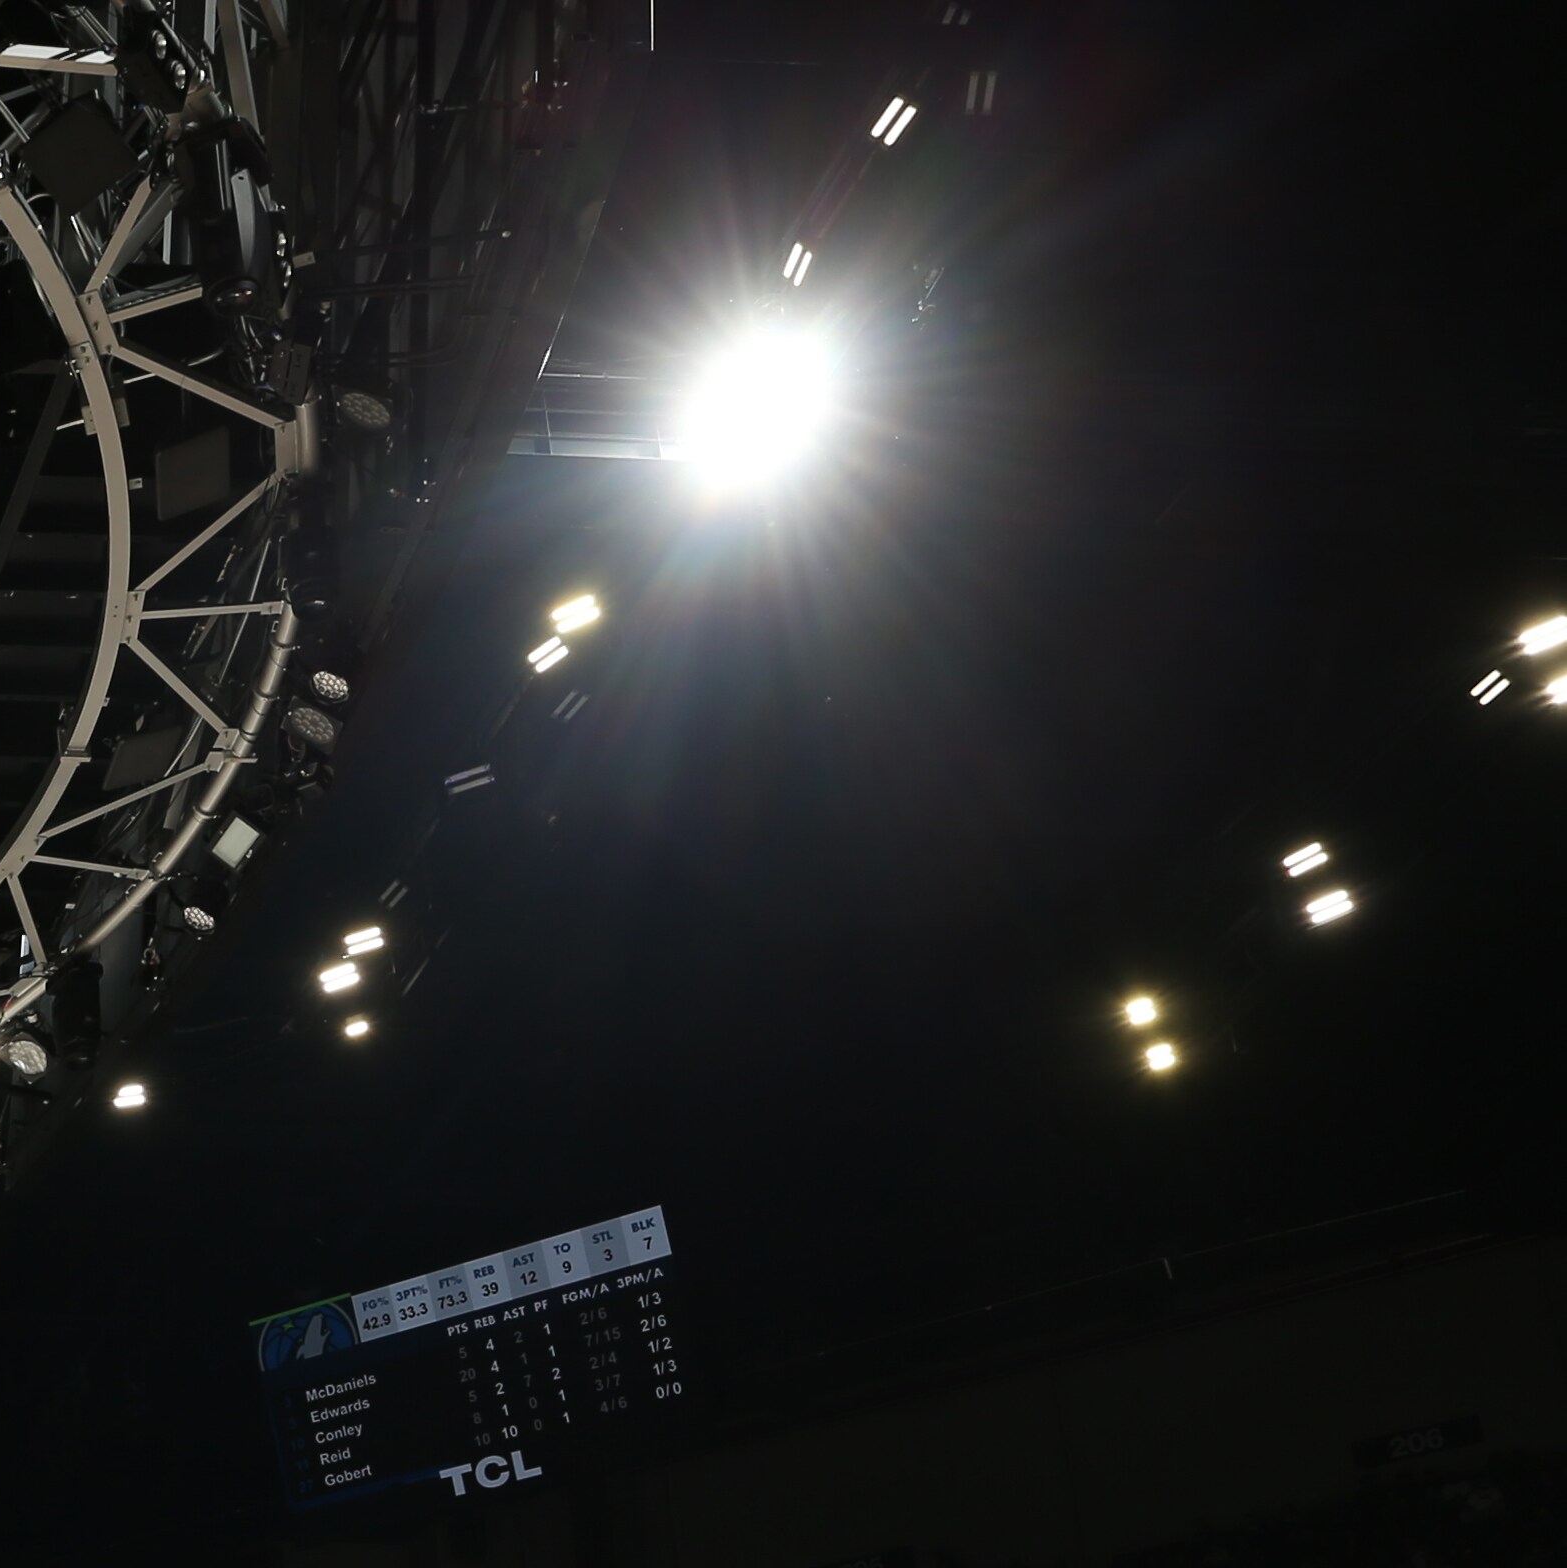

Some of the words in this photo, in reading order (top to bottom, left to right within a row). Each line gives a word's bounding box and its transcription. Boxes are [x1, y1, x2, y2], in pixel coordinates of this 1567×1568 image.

[362, 1296, 389, 1312] FG%
[395, 1285, 429, 1302] 3PT%
[439, 1275, 463, 1289] FT%
[473, 1264, 496, 1280] REB
[512, 1253, 536, 1269] AST
[553, 1242, 571, 1256] TO
[592, 1230, 614, 1245] STL
[631, 1217, 656, 1233] BLK
[362, 1313, 392, 1332] 42.9
[399, 1302, 429, 1321] 33.3
[437, 1291, 468, 1310] 73.3
[481, 1282, 499, 1297] 39
[520, 1270, 538, 1285] 12
[562, 1261, 572, 1273] 9
[603, 1248, 614, 1262] 3
[643, 1237, 653, 1250] 7
[447, 1322, 469, 1337] PTS
[474, 1315, 497, 1329] REB
[503, 1305, 526, 1321] AST
[534, 1300, 549, 1312] PF
[561, 1282, 611, 1304] FGM/A
[616, 1267, 664, 1289] 3PM/A
[305, 1373, 377, 1403] McDaniels
[310, 1398, 371, 1424] Edwards
[315, 1423, 363, 1445] Conley
[319, 1447, 352, 1466] Reid
[324, 1464, 373, 1487] Gobert
[438, 1450, 543, 1497] TCL
